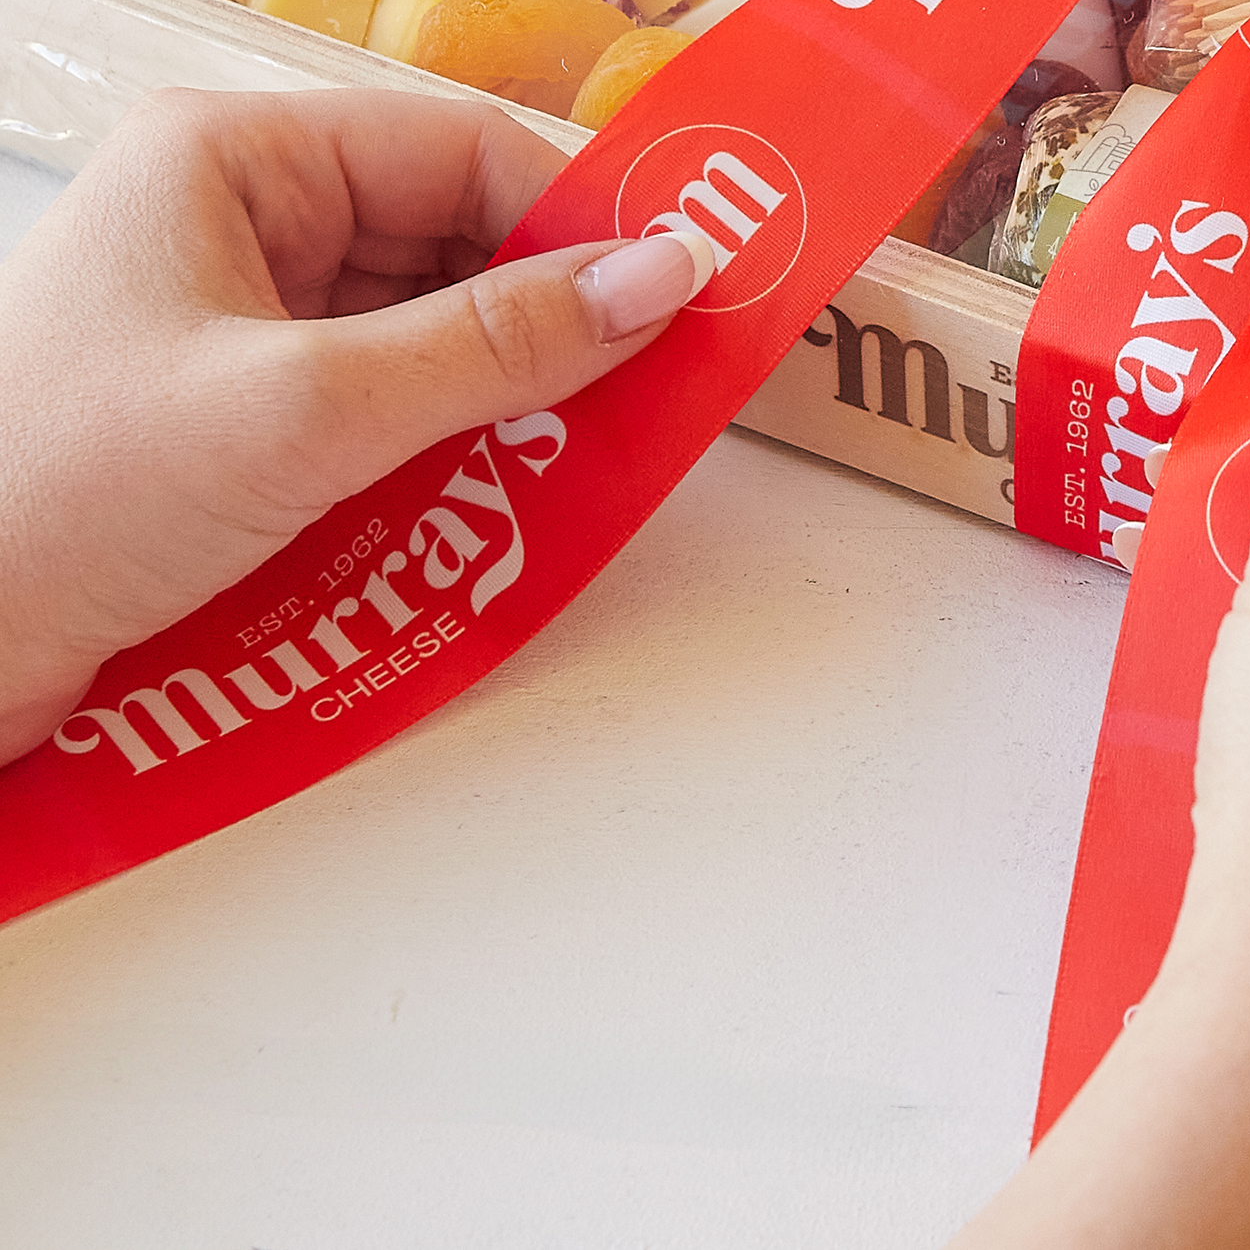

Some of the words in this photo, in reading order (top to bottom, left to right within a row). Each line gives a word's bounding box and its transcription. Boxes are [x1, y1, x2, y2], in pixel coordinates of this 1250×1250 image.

[1066, 380, 1095, 458] 1962
[1065, 466, 1087, 530] EST.
[52, 410, 568, 776] Murrays
[236, 594, 317, 650] EST.
[319, 517, 389, 590] 1962
[310, 611, 466, 723] CHEESE
